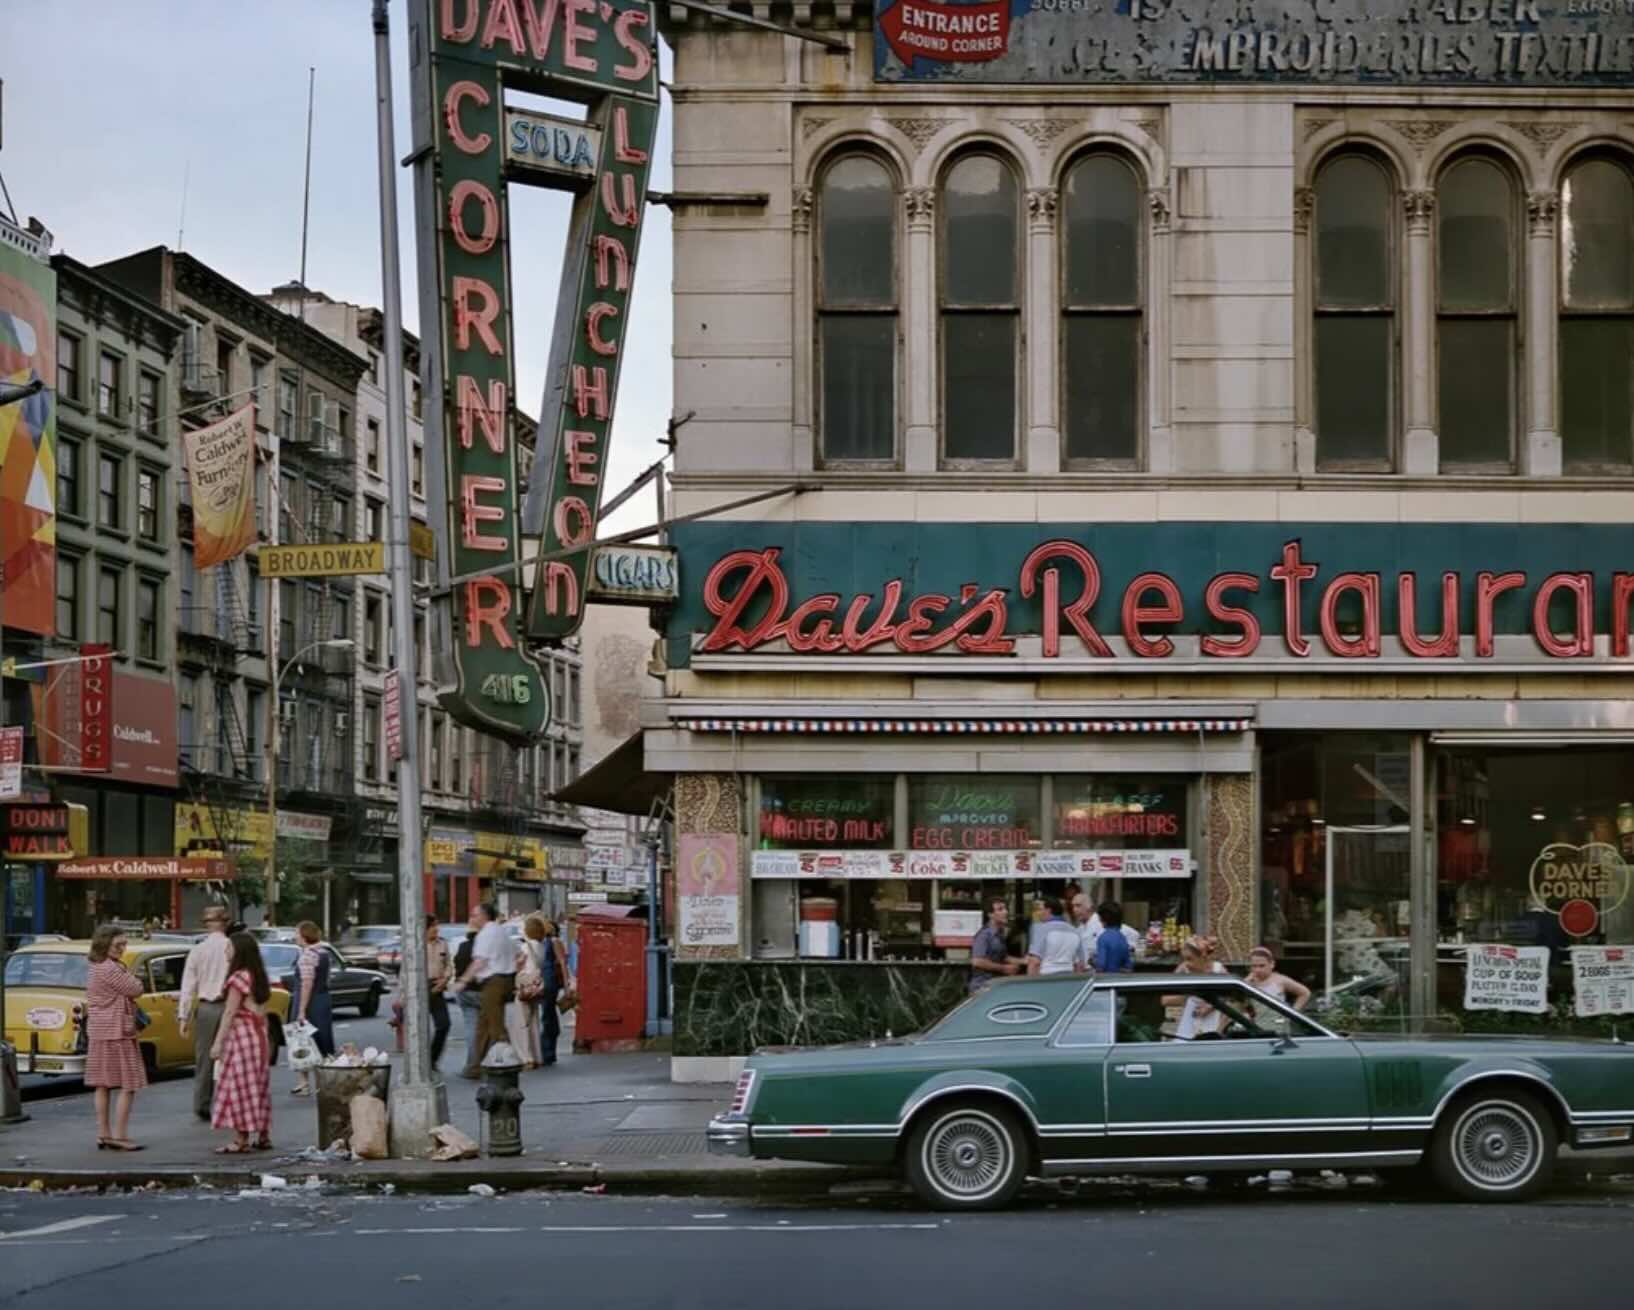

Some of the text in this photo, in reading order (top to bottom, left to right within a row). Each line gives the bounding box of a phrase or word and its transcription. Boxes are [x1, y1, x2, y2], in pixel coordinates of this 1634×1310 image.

[902, 5, 999, 33] ENTRANCE
[441, 0, 650, 81] DAVE'S
[900, 31, 1002, 52] AROUND CORNER
[510, 120, 595, 168] SODA
[444, 81, 512, 648] CORNER
[268, 549, 375, 572] BROADWAY
[596, 552, 675, 591] CIGARS
[703, 545, 1015, 653] Dave's
[481, 674, 529, 703] 416
[85, 657, 102, 758] DRUGS
[913, 827, 953, 849] EGG
[57, 863, 97, 874] Robert
[113, 860, 178, 875] Caldwell
[910, 860, 946, 875] Coke
[1472, 967, 1495, 979] CUP
[1514, 970, 1542, 981] SOUP
